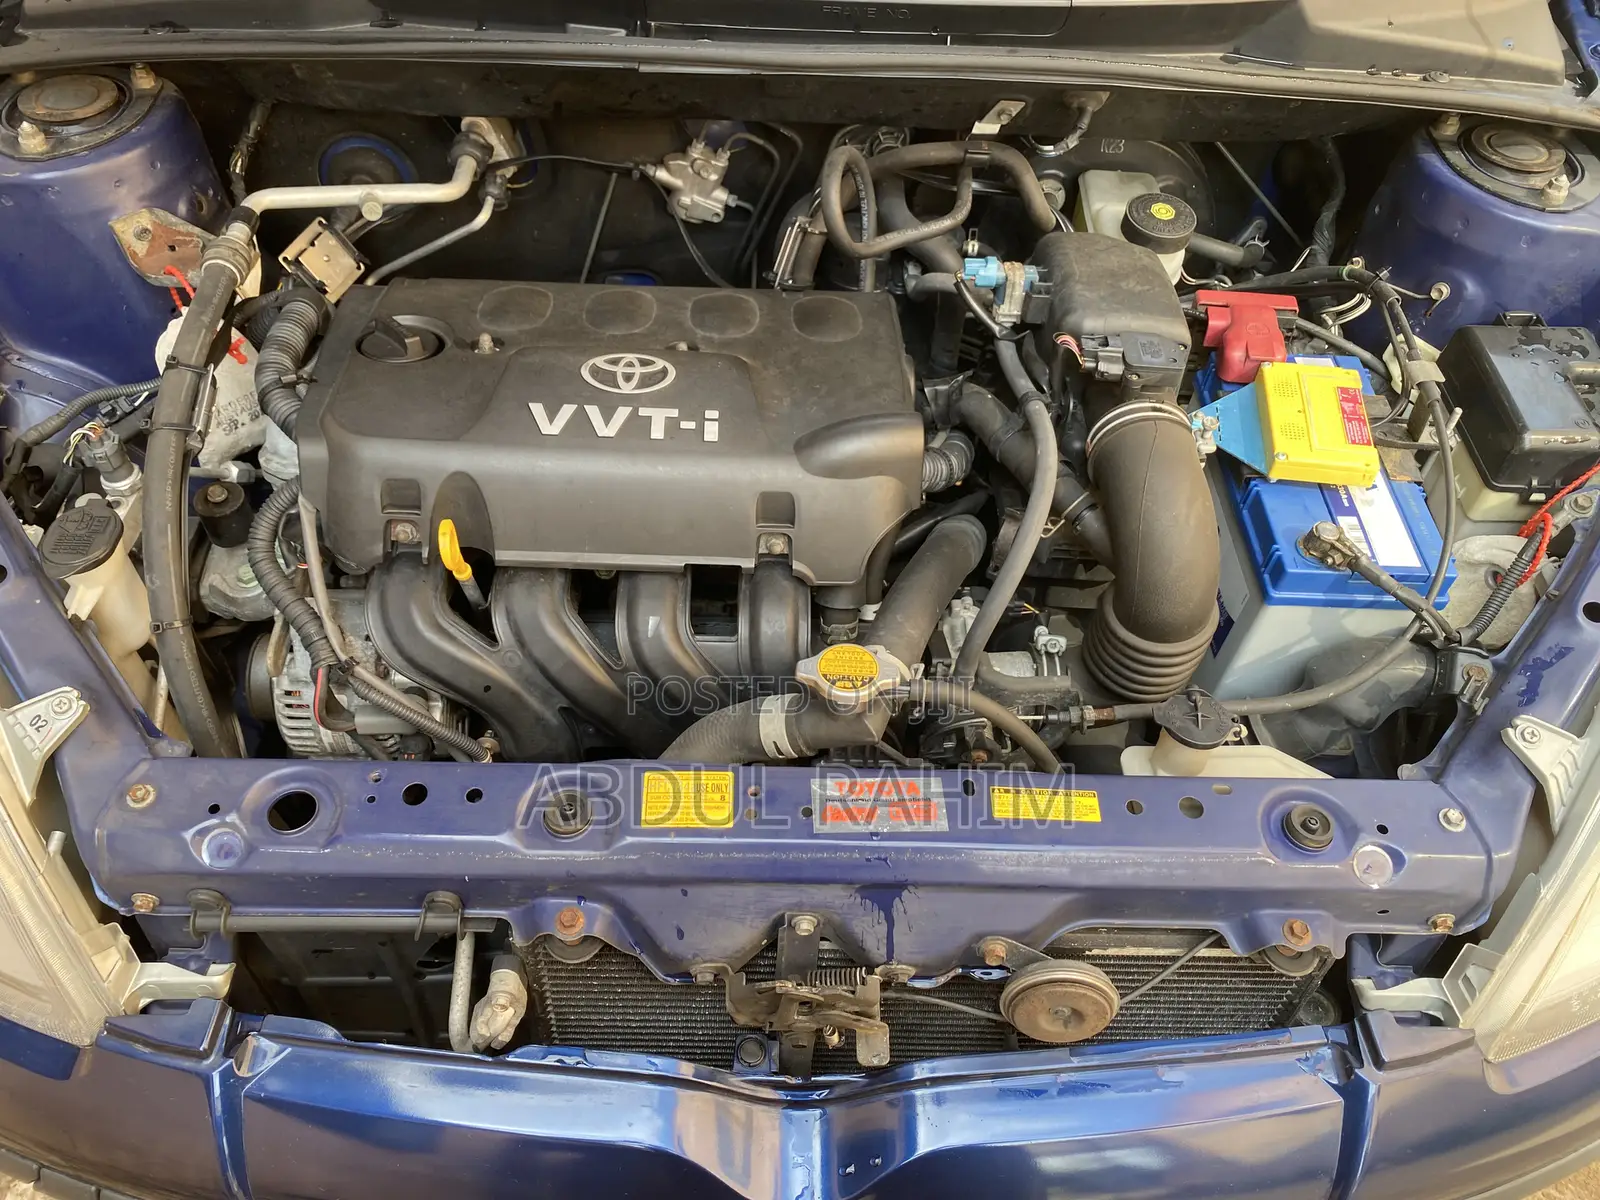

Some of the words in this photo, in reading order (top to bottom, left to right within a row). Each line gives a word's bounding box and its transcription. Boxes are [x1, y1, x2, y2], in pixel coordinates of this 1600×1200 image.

[528, 402, 719, 442] VVT-i
[29, 714, 49, 733] 02
[711, 783, 729, 793] ONLY
[833, 780, 921, 796] TOYOTA
